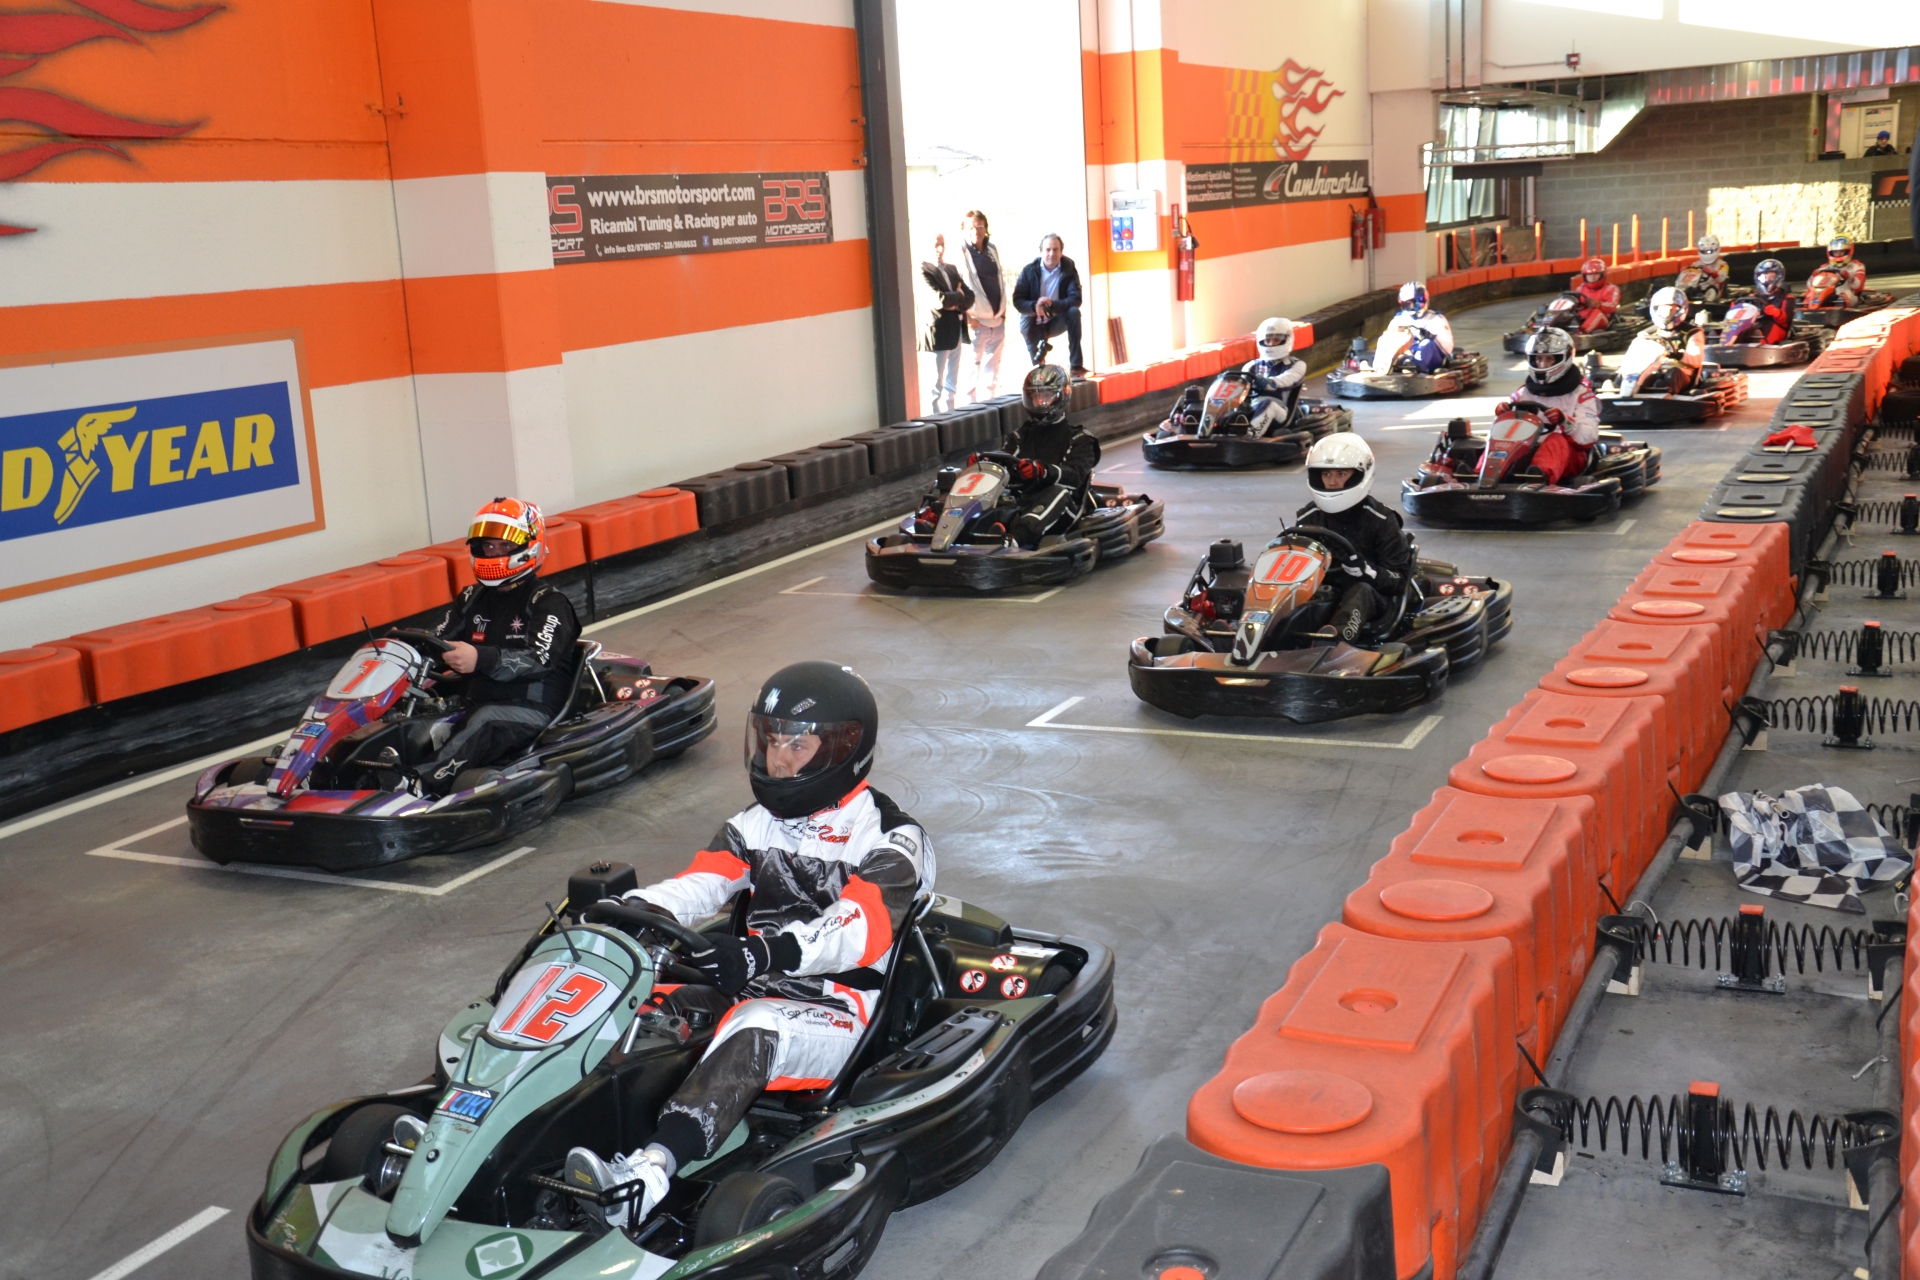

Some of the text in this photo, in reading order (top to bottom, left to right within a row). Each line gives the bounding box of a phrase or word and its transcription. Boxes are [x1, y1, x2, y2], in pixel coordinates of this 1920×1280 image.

[587, 184, 756, 207] www.brsmotorsport.com
[763, 179, 825, 222] BRS
[590, 212, 758, 235] Ricambi Tuning & Racing per auto
[765, 222, 826, 236] MOTORSPORT
[724, 235, 758, 245] MOTORSPORT
[957, 473, 985, 495] 3
[1264, 552, 1312, 582] 10
[498, 964, 607, 1043] 12
[776, 1006, 801, 1020] Top
